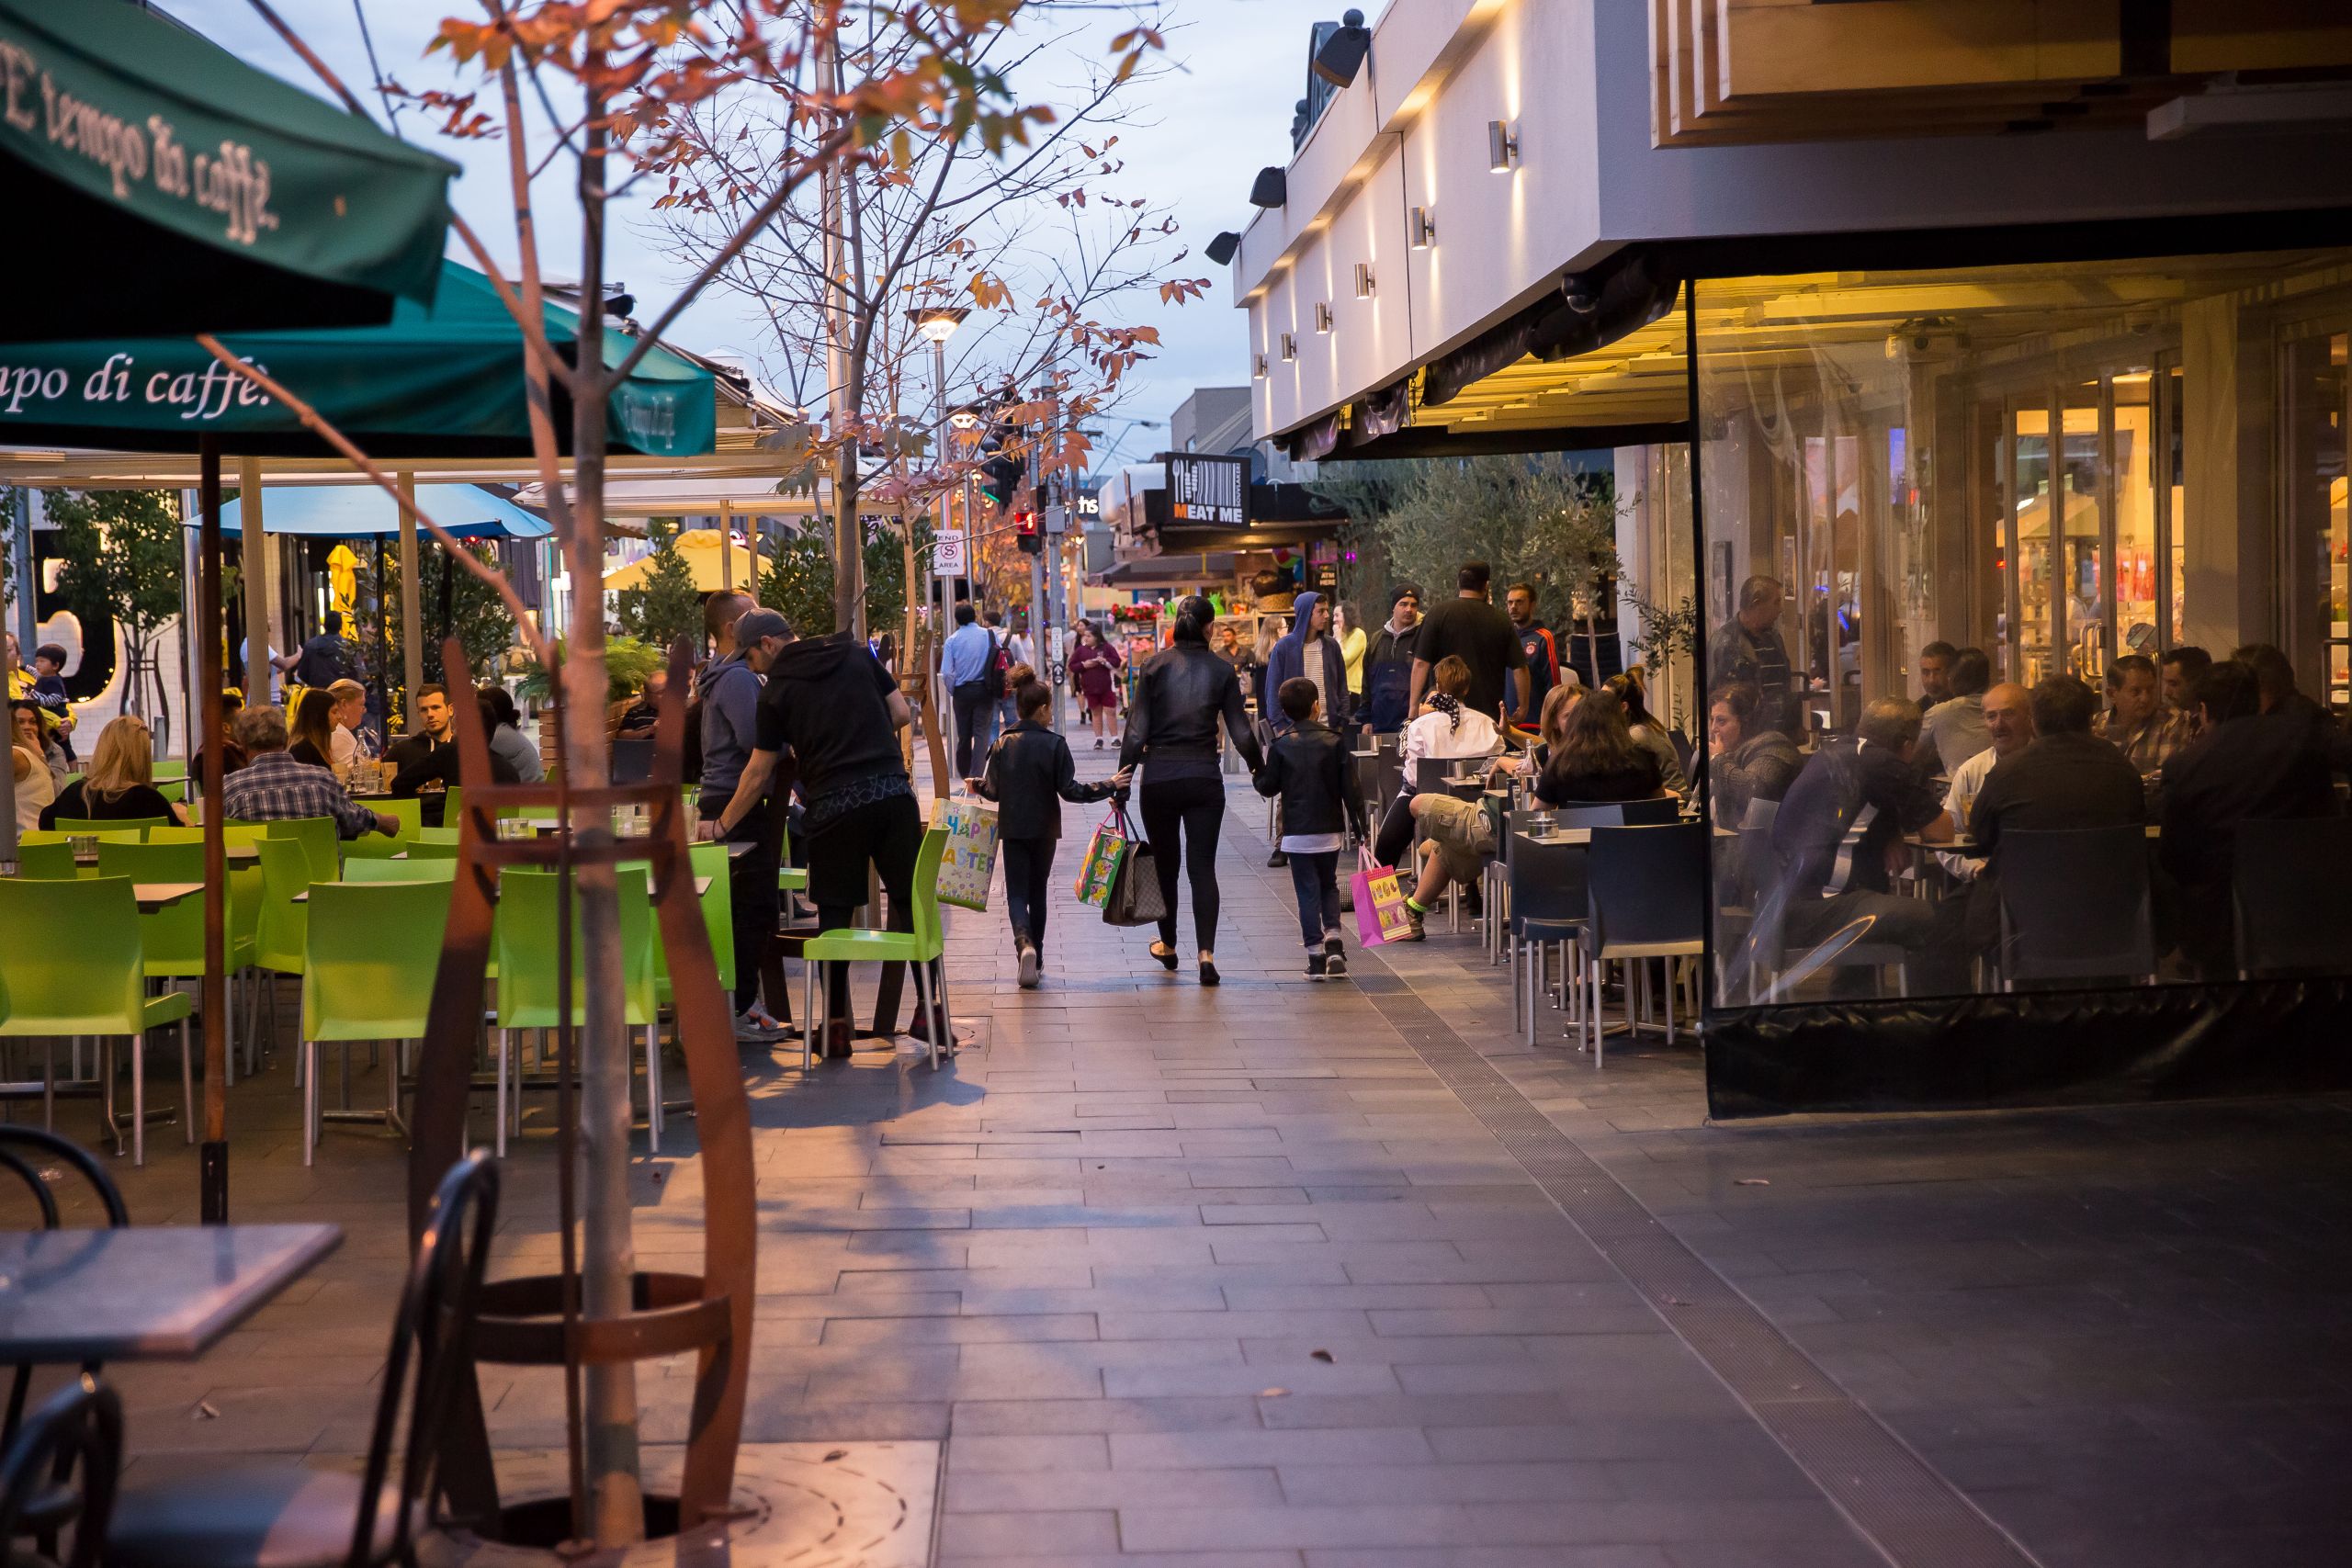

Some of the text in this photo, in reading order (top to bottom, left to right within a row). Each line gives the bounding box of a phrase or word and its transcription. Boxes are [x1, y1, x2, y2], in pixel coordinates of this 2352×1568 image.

[40, 70, 149, 199] tempo
[83, 352, 134, 401] di
[1174, 503, 1242, 523] MEAT ME
[942, 846, 994, 874] ASTER
